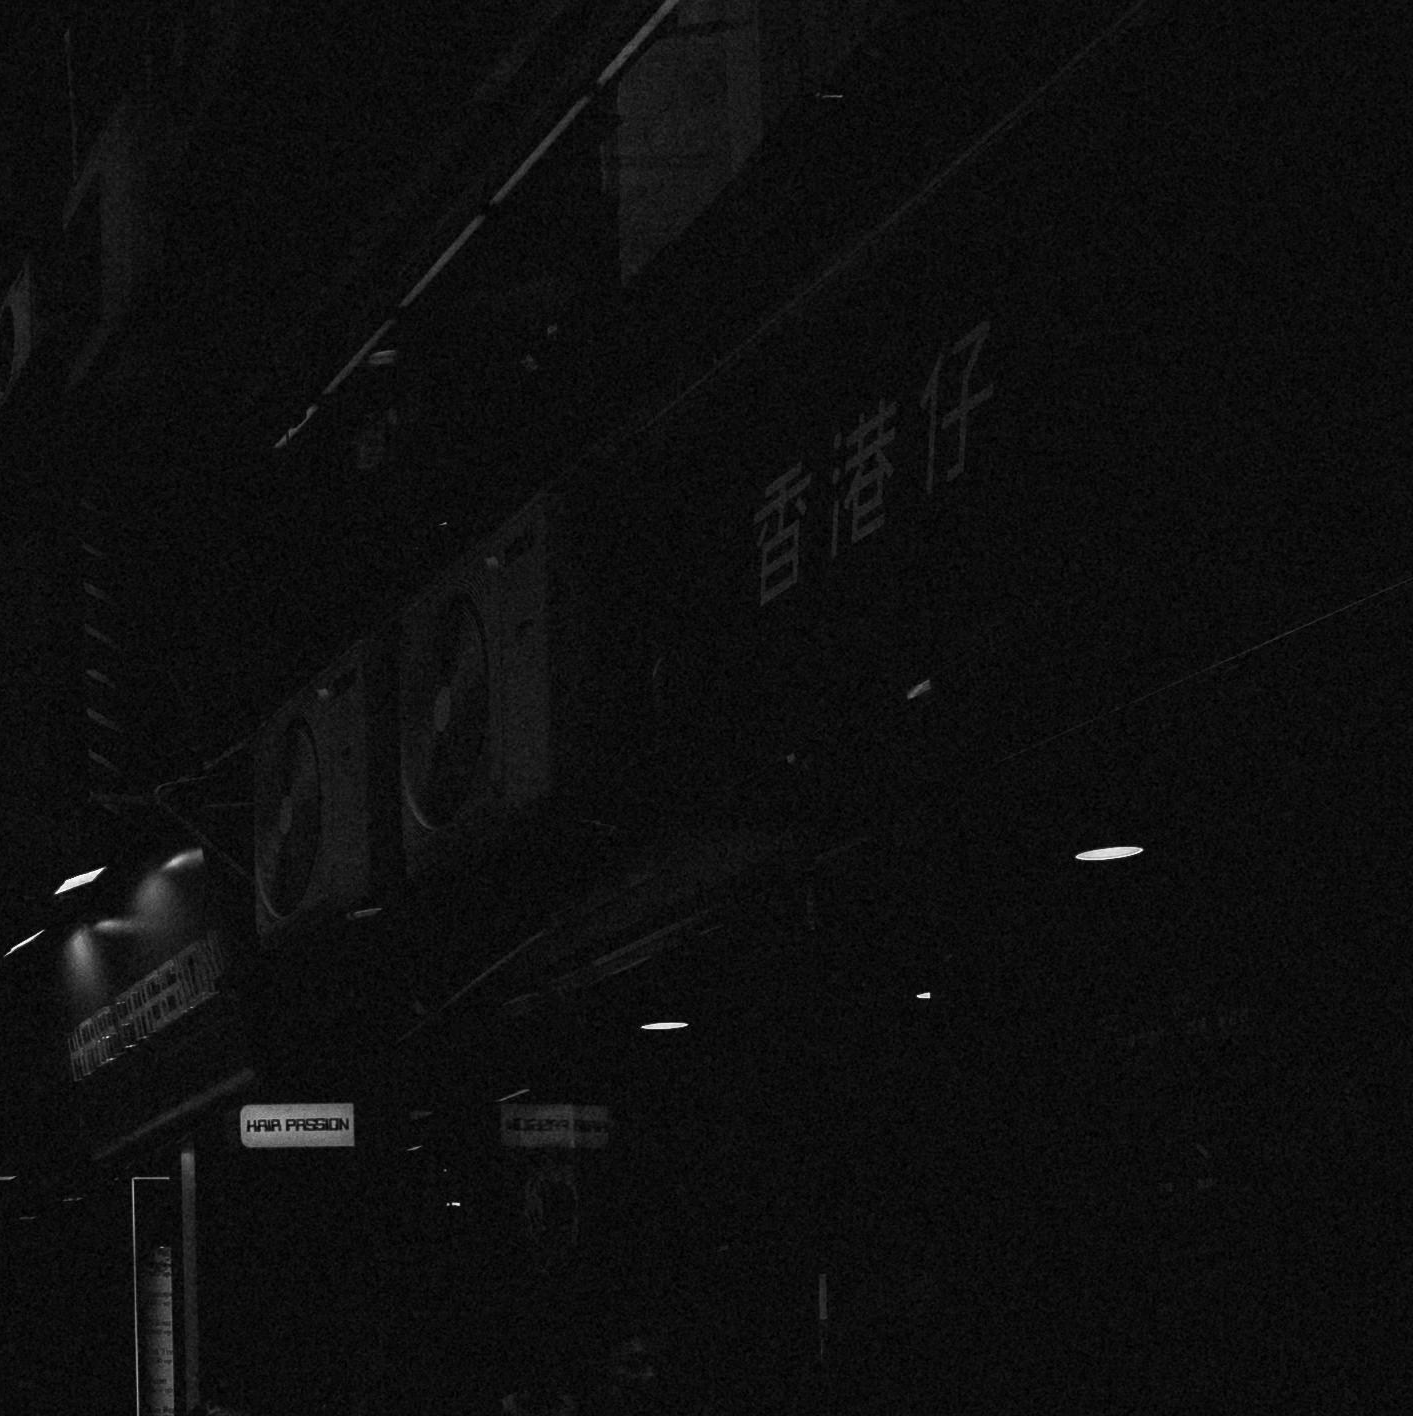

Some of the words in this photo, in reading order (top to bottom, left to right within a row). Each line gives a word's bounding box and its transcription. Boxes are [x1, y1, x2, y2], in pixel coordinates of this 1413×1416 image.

[753, 320, 995, 606] 香港仔
[246, 1118, 282, 1132] HAIR
[285, 1117, 350, 1132] PASSION
